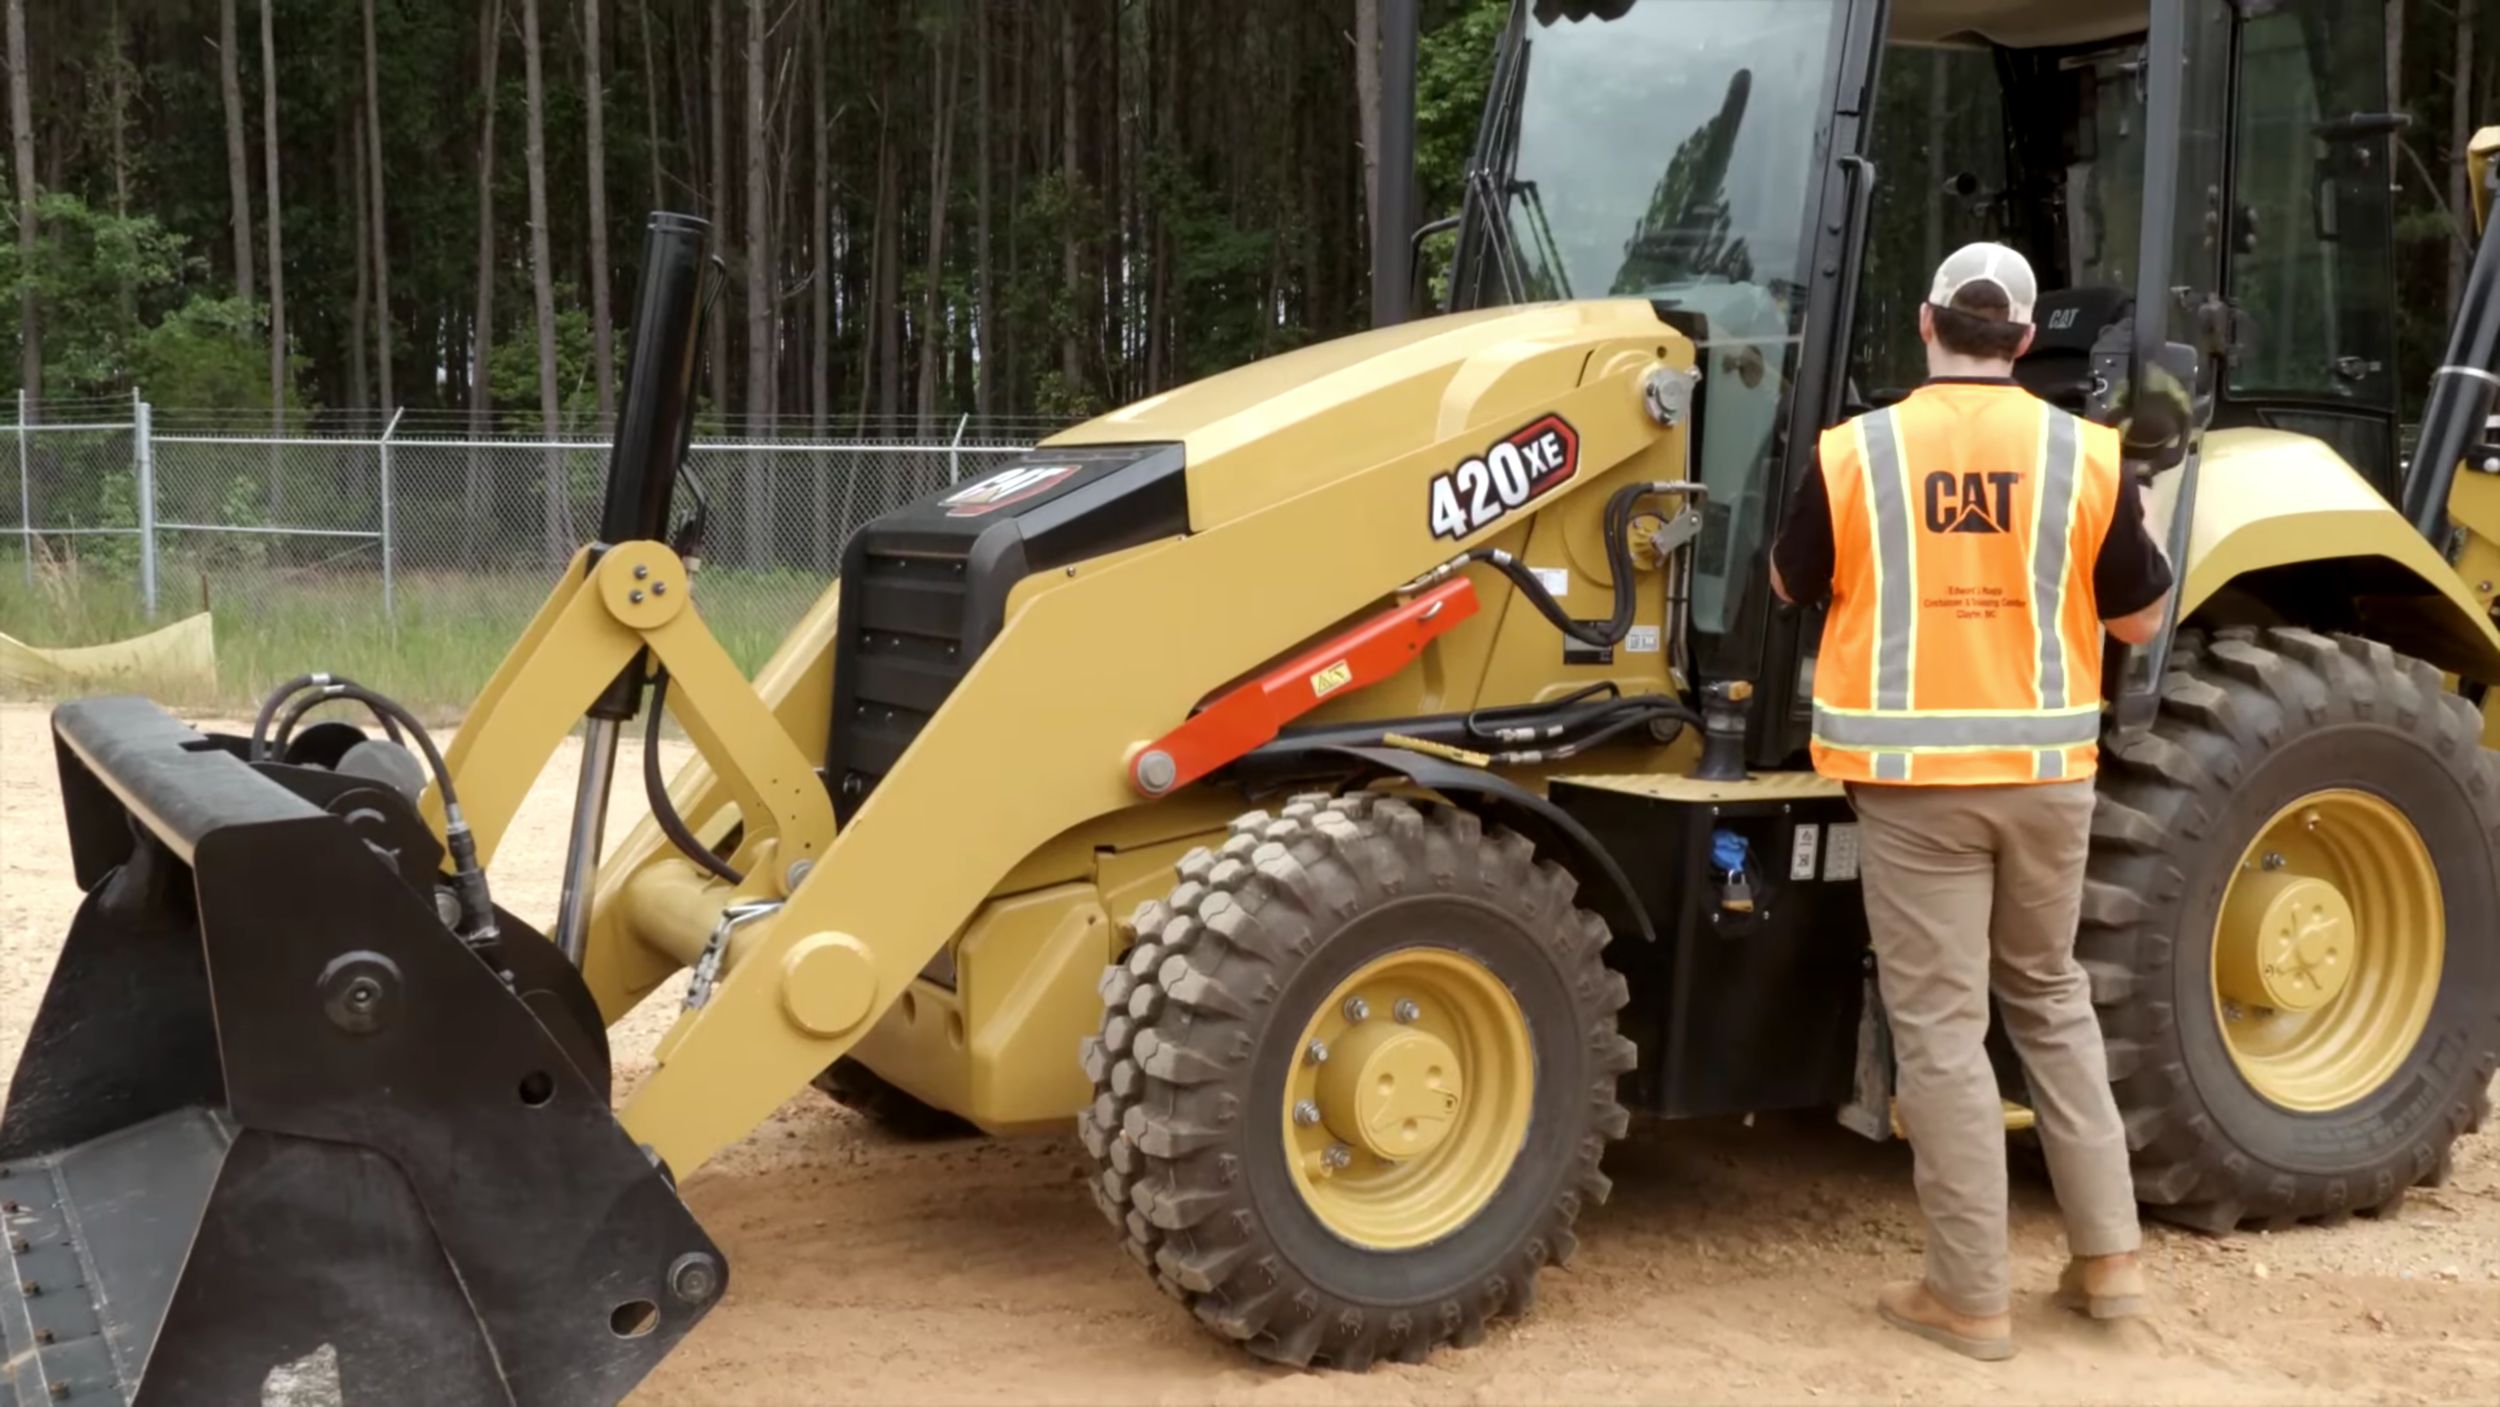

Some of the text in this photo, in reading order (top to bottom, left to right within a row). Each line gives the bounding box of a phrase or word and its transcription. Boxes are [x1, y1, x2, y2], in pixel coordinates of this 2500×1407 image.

[2048, 308, 2079, 328] CAT
[1431, 431, 1565, 538] 420XE
[1924, 470, 2019, 534] CAT
